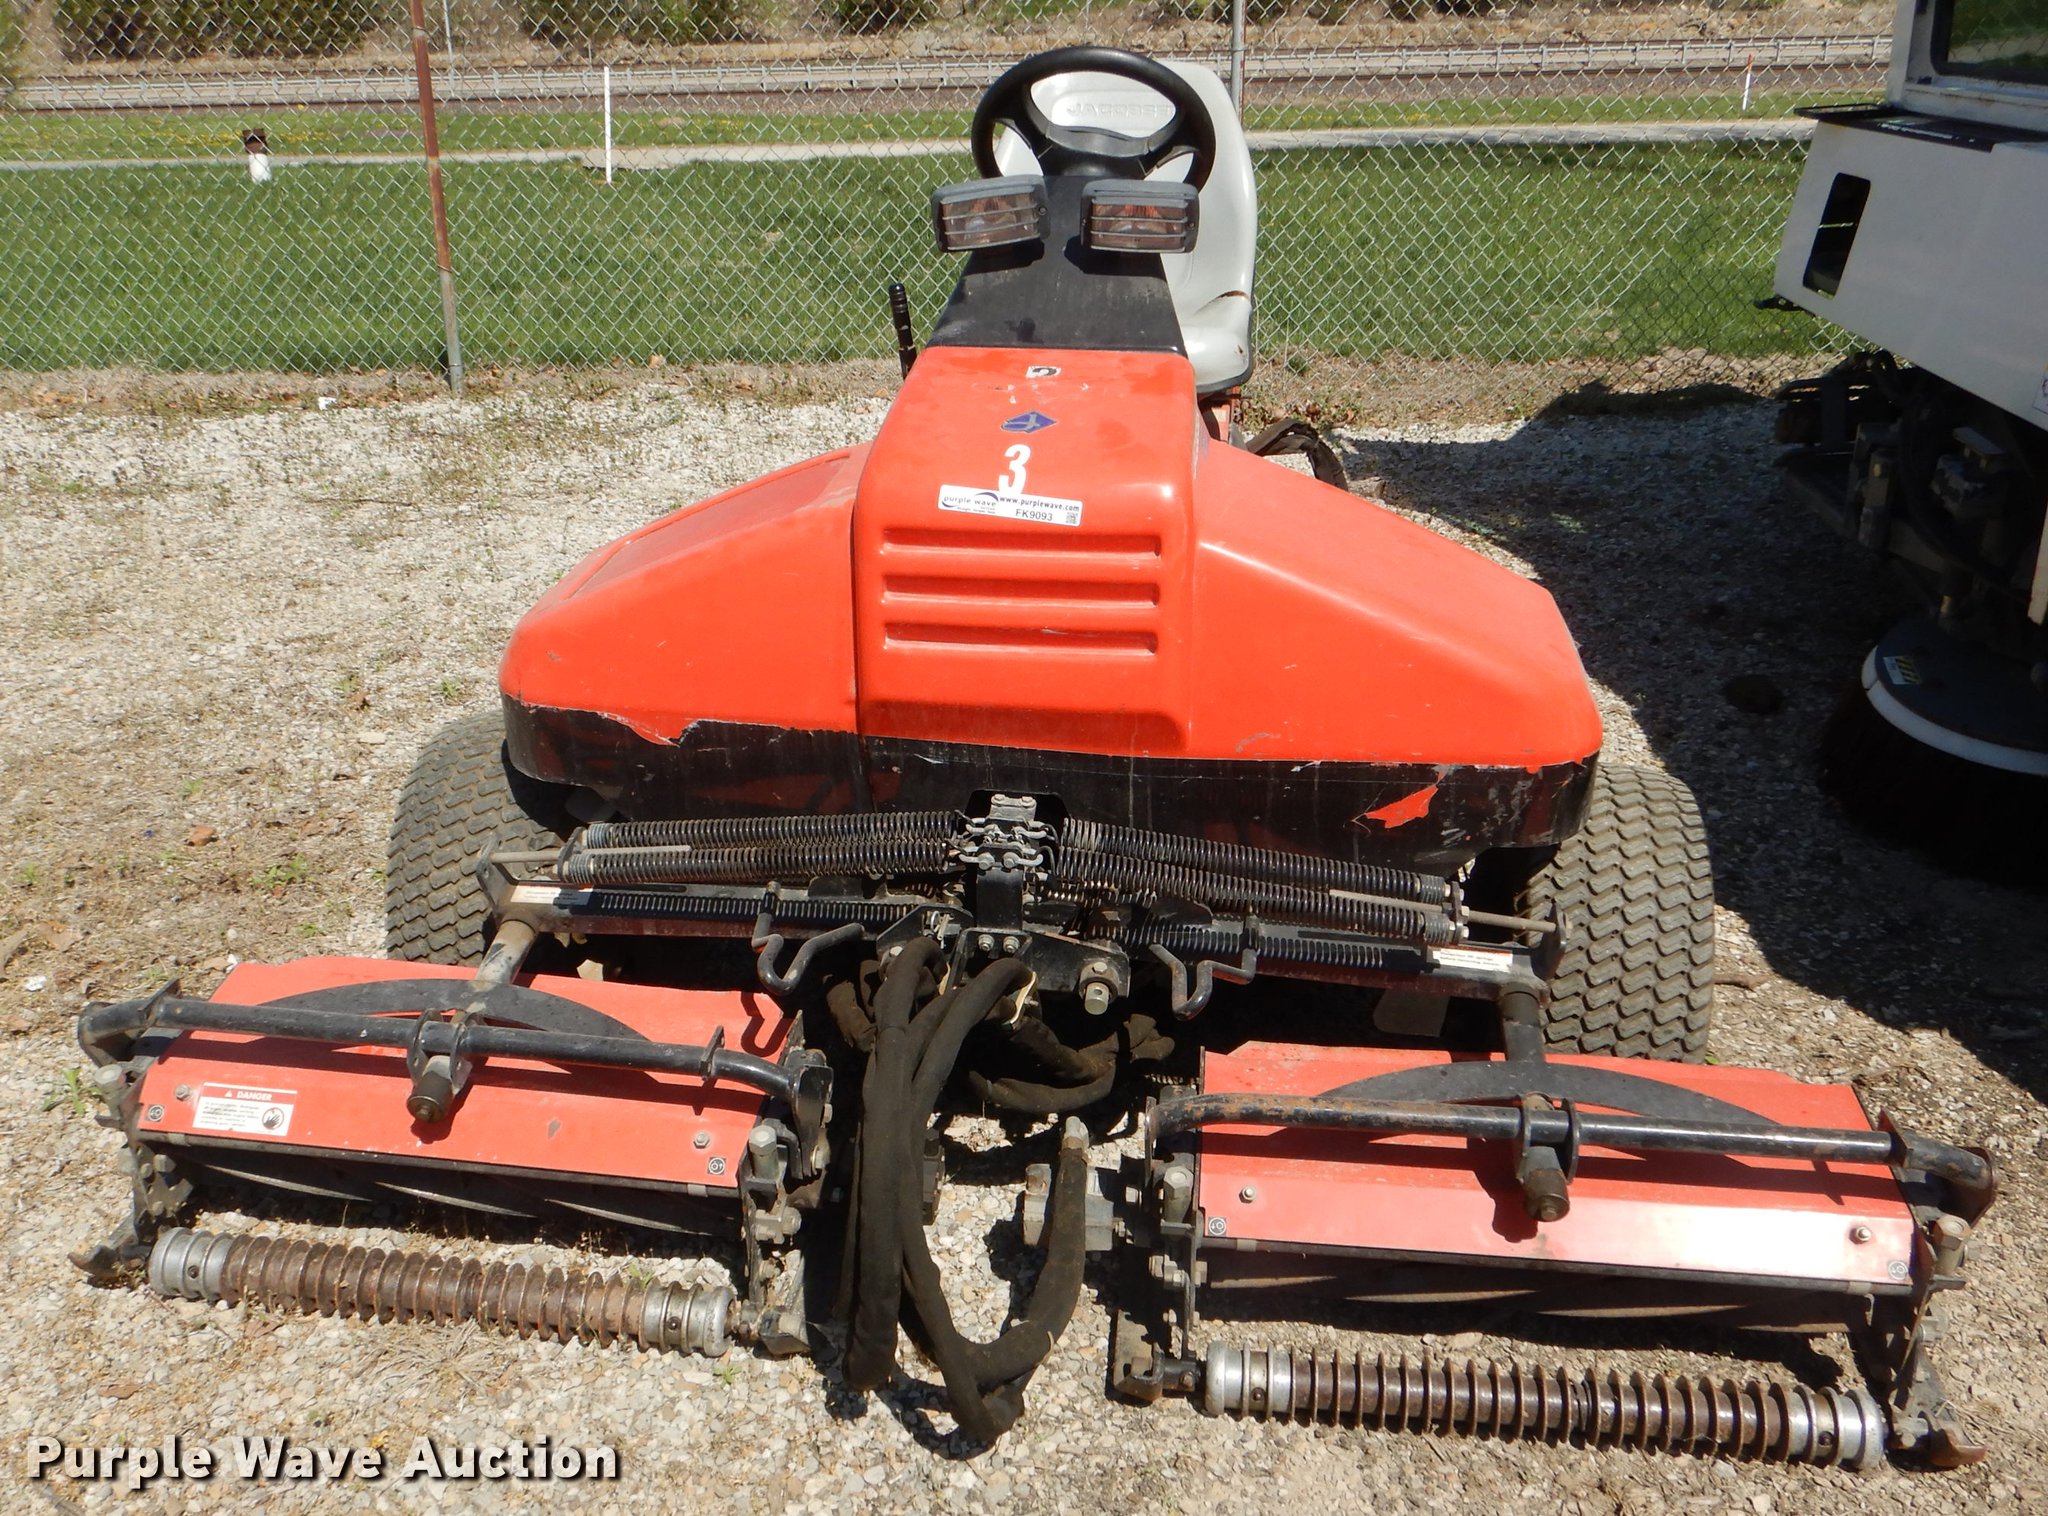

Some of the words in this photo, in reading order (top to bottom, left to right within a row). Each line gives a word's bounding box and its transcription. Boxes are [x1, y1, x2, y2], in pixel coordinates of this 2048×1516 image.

[998, 443, 1032, 494] 3
[943, 496, 971, 506] purple
[974, 499, 997, 507] wave
[999, 497, 1080, 511] www.purplewave.com
[1015, 508, 1053, 521] FK9093
[236, 1090, 272, 1101] DANGER
